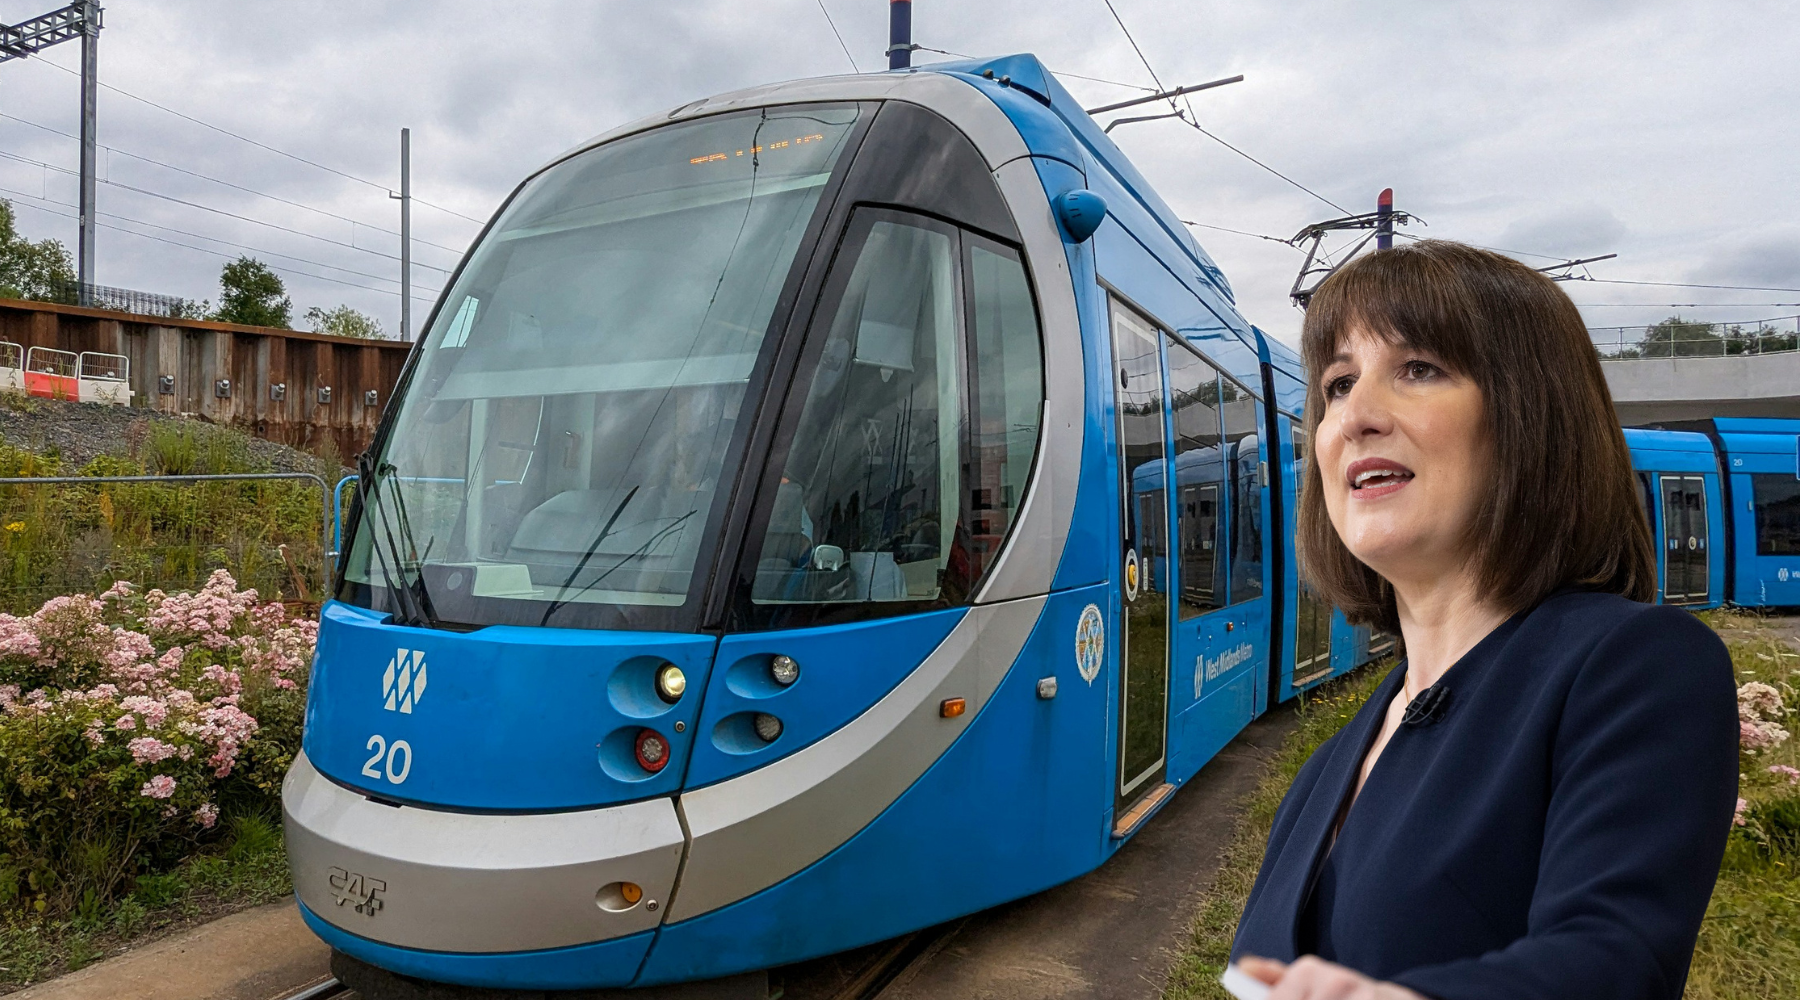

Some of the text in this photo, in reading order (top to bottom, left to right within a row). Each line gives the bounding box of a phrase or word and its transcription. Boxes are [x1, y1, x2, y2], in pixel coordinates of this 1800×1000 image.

[1206, 656, 1219, 682] West
[361, 734, 412, 785] 20
[328, 866, 386, 916] CAF
